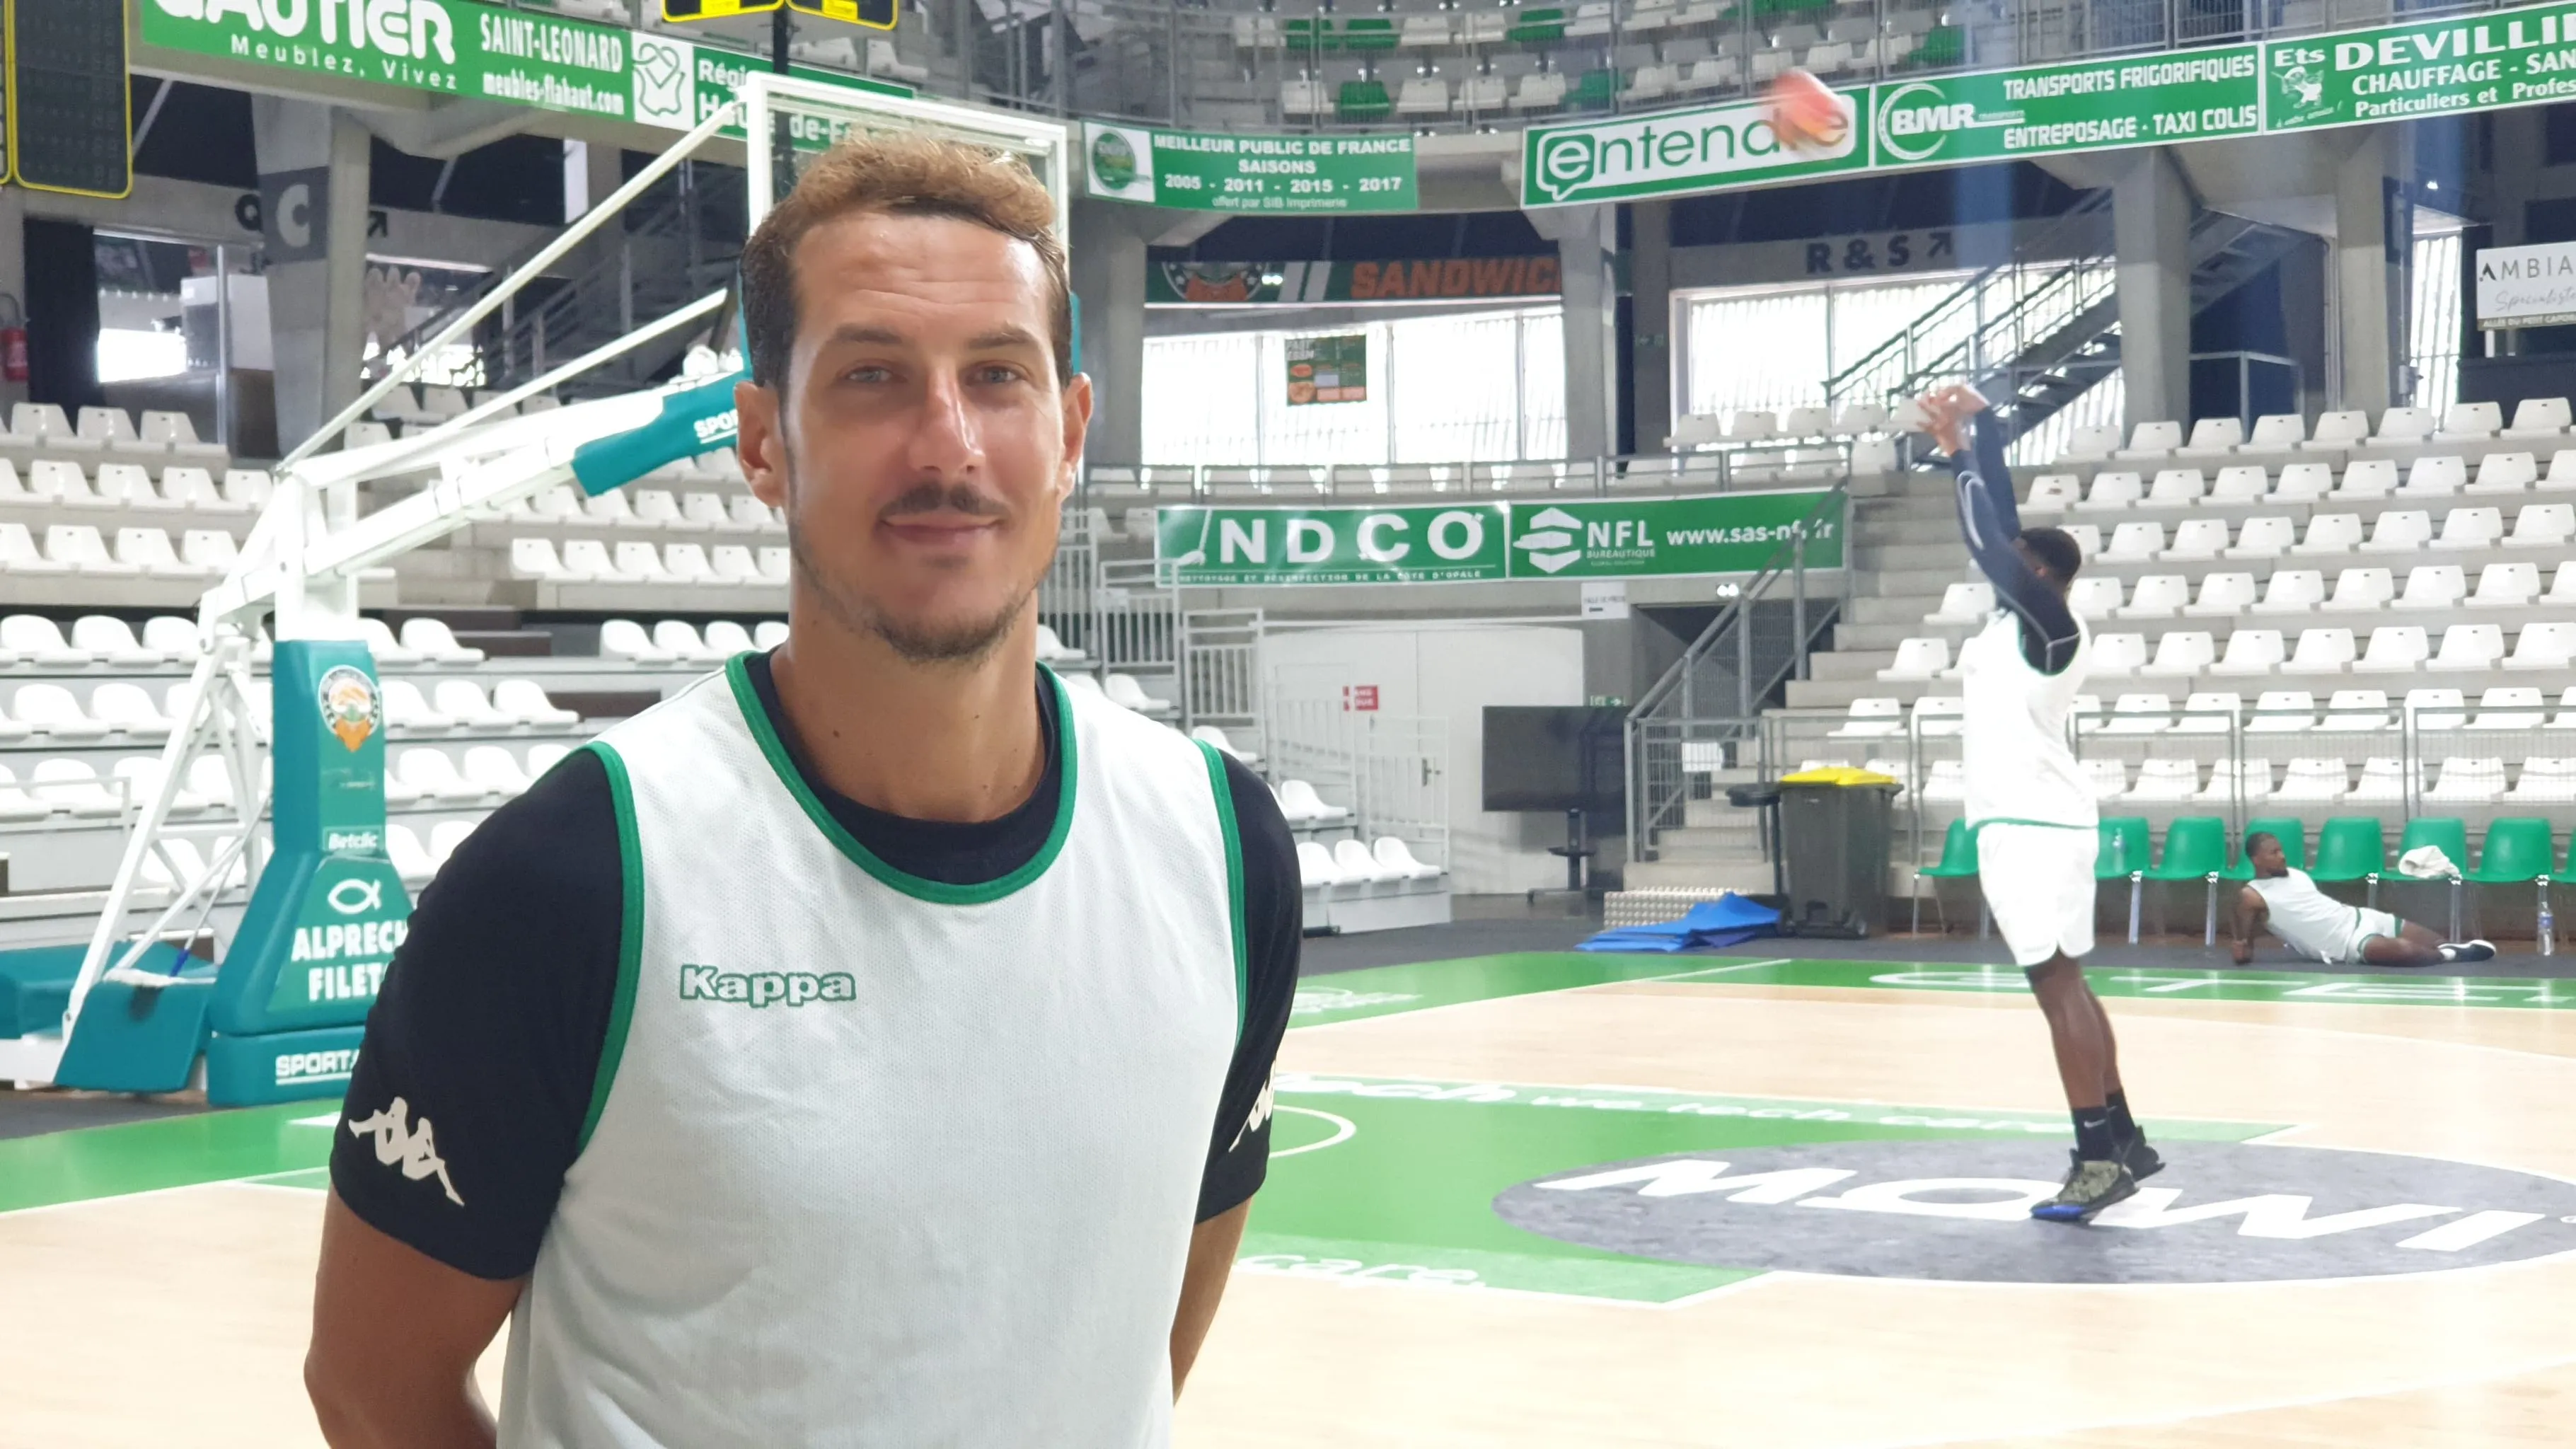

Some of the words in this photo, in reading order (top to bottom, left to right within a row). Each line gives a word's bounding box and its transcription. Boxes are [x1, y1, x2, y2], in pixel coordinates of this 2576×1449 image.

[231, 33, 365, 77] Meublez,
[382, 59, 457, 89] Vivez
[480, 13, 623, 72] SAINT-LEONARD
[2275, 48, 2326, 67] Ets
[483, 69, 625, 115] meubles-flahaut.com
[698, 58, 747, 92] Régi
[2003, 71, 2115, 100] TRANSPORTS
[2120, 54, 2255, 88] FRIGORIFIQUES
[2352, 59, 2502, 96] CHAUFFAGE
[1891, 103, 1976, 135] BMR
[2355, 91, 2470, 117] Particuliers
[2477, 87, 2498, 104] et
[1154, 134, 1235, 154] MEILLEUR
[1240, 139, 1303, 155] PUBLIC
[1308, 140, 1332, 155] DE
[1338, 139, 1412, 155] FRANCE
[2004, 117, 2137, 149] ENTREPOSAGE
[2154, 111, 2197, 135] TAXI
[2202, 105, 2257, 128] COLIS
[1165, 174, 1202, 190] 2005
[1223, 178, 1264, 192] 2011
[1290, 178, 1333, 193] 2015
[1358, 177, 1403, 192] 2017
[1238, 159, 1316, 174] SAISONS
[275, 183, 311, 248] C
[1806, 242, 1832, 273] R
[1844, 238, 1876, 270] &
[1887, 233, 1910, 266] S
[1587, 519, 1655, 548] NFL
[1586, 548, 1656, 558] BUREAUTIQUE
[308, 962, 388, 1002] FILET
[680, 964, 857, 1008] Kappa
[1532, 1158, 2548, 1252] MOWI
